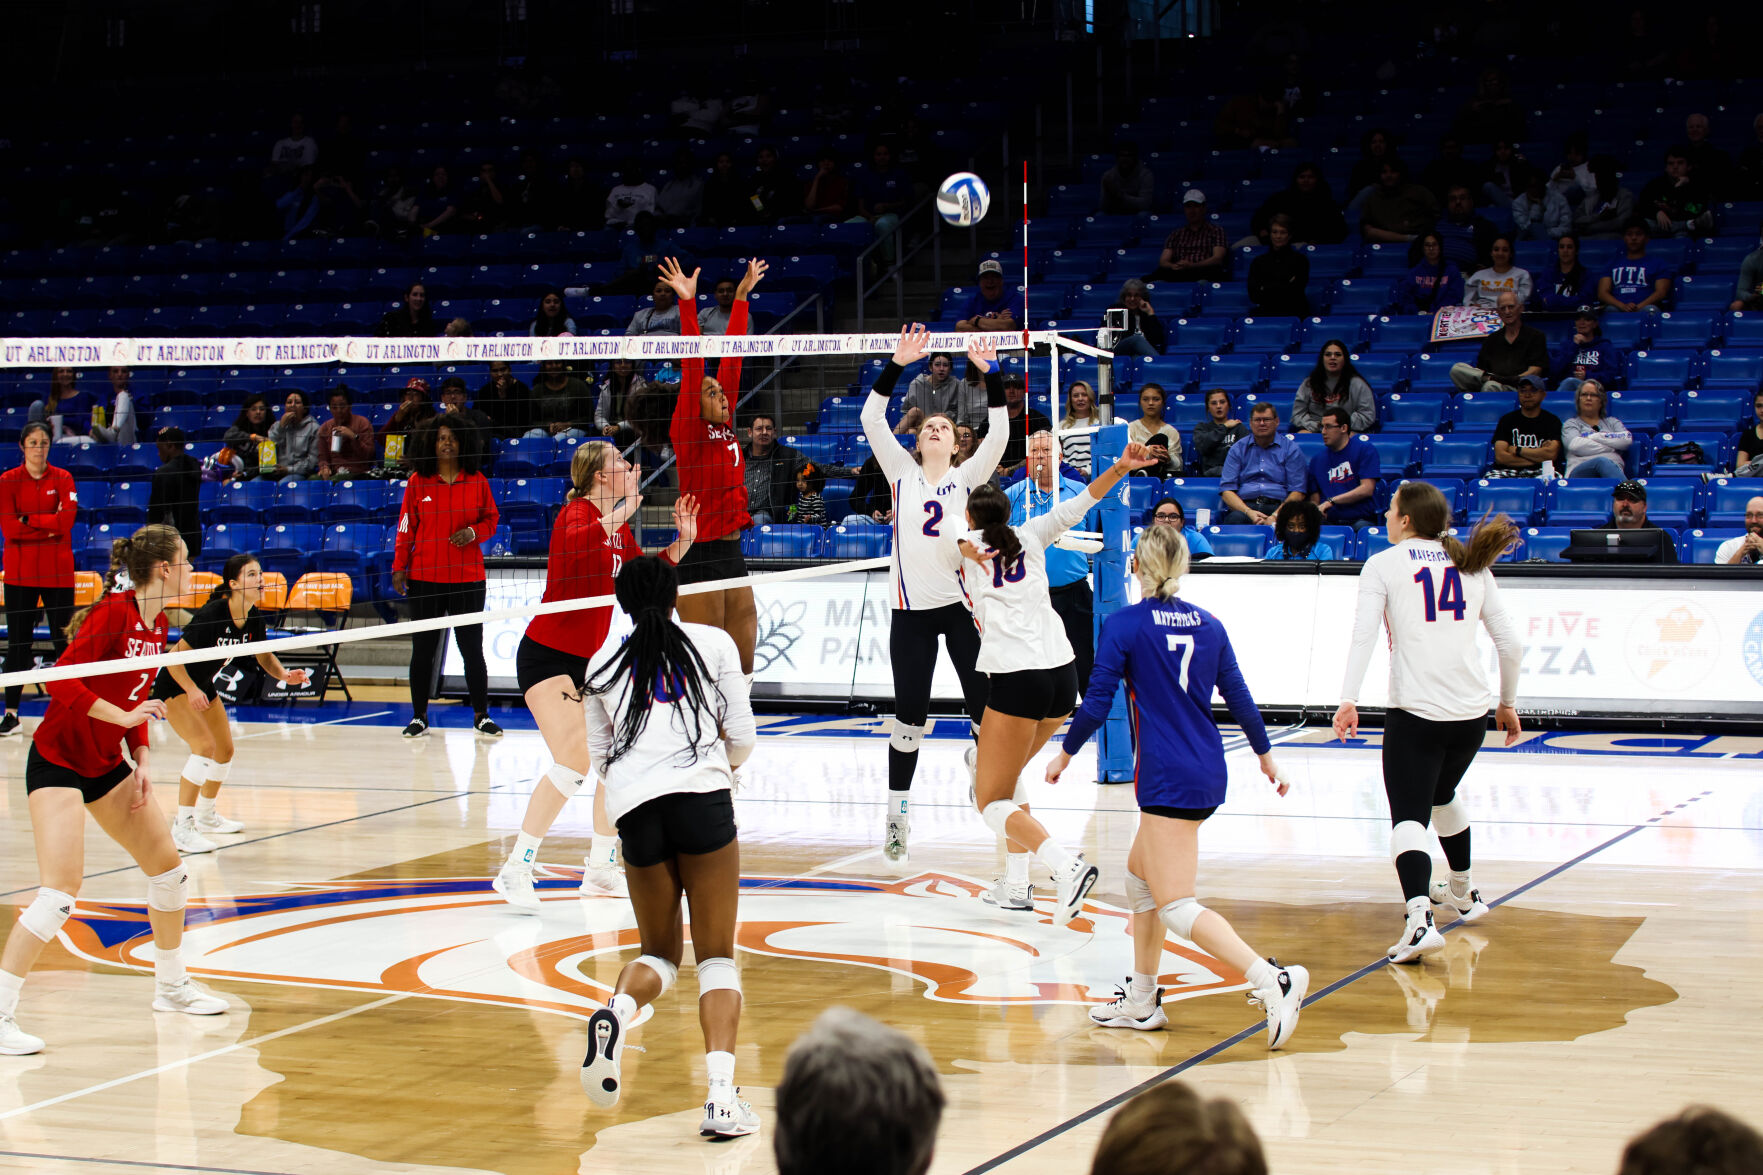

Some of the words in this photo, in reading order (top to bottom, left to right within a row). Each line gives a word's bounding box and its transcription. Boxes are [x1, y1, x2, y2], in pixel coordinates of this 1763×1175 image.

[1612, 266, 1648, 286] UTA
[5, 346, 21, 362] UT
[27, 345, 101, 362] ARLINGTON
[157, 345, 224, 361] ARLINGTON
[727, 442, 740, 467] 7
[922, 500, 943, 537] 2
[1409, 548, 1451, 562] MAVERICK
[1413, 566, 1467, 622] 14
[1152, 609, 1202, 628] MAVERICKS
[1527, 611, 1601, 639] FIVE
[1165, 634, 1195, 694] 7
[1489, 645, 1596, 677] IZZA
[127, 672, 149, 701] 2
